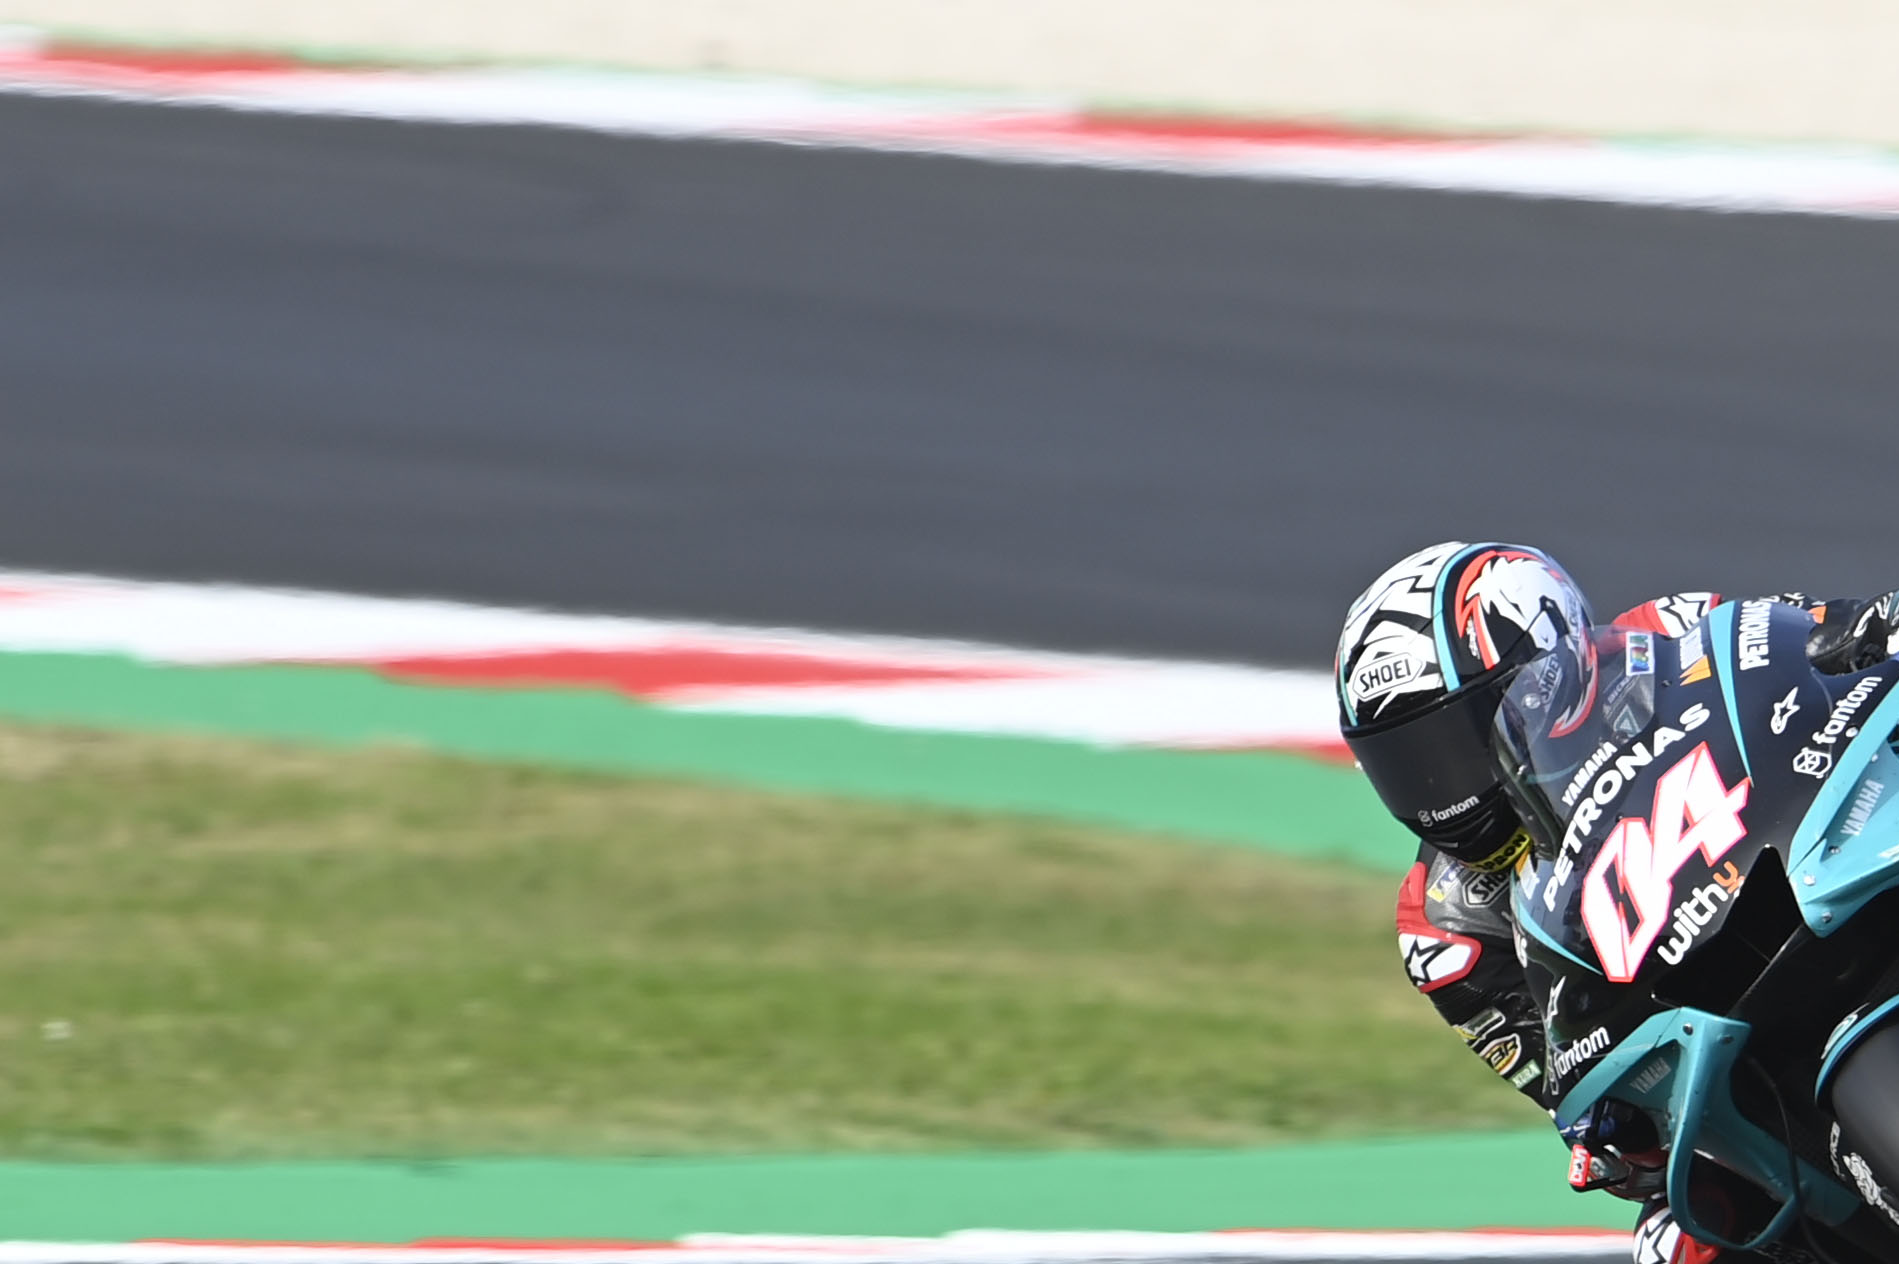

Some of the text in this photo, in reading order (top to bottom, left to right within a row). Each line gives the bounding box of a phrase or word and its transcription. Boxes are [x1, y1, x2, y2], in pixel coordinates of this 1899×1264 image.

[1738, 599, 1772, 670] PETRONAS
[1360, 658, 1411, 693] SHOEI
[1812, 676, 1883, 744] fantom
[1561, 741, 1618, 806] YAMAHA
[1431, 795, 1480, 822] fantom
[1543, 702, 1710, 912] PETRONAS
[1840, 778, 1885, 836] YAMAHA
[1580, 740, 1751, 983] 04
[1553, 1026, 1611, 1080] fantom
[1629, 1056, 1672, 1095] YAMAHA
